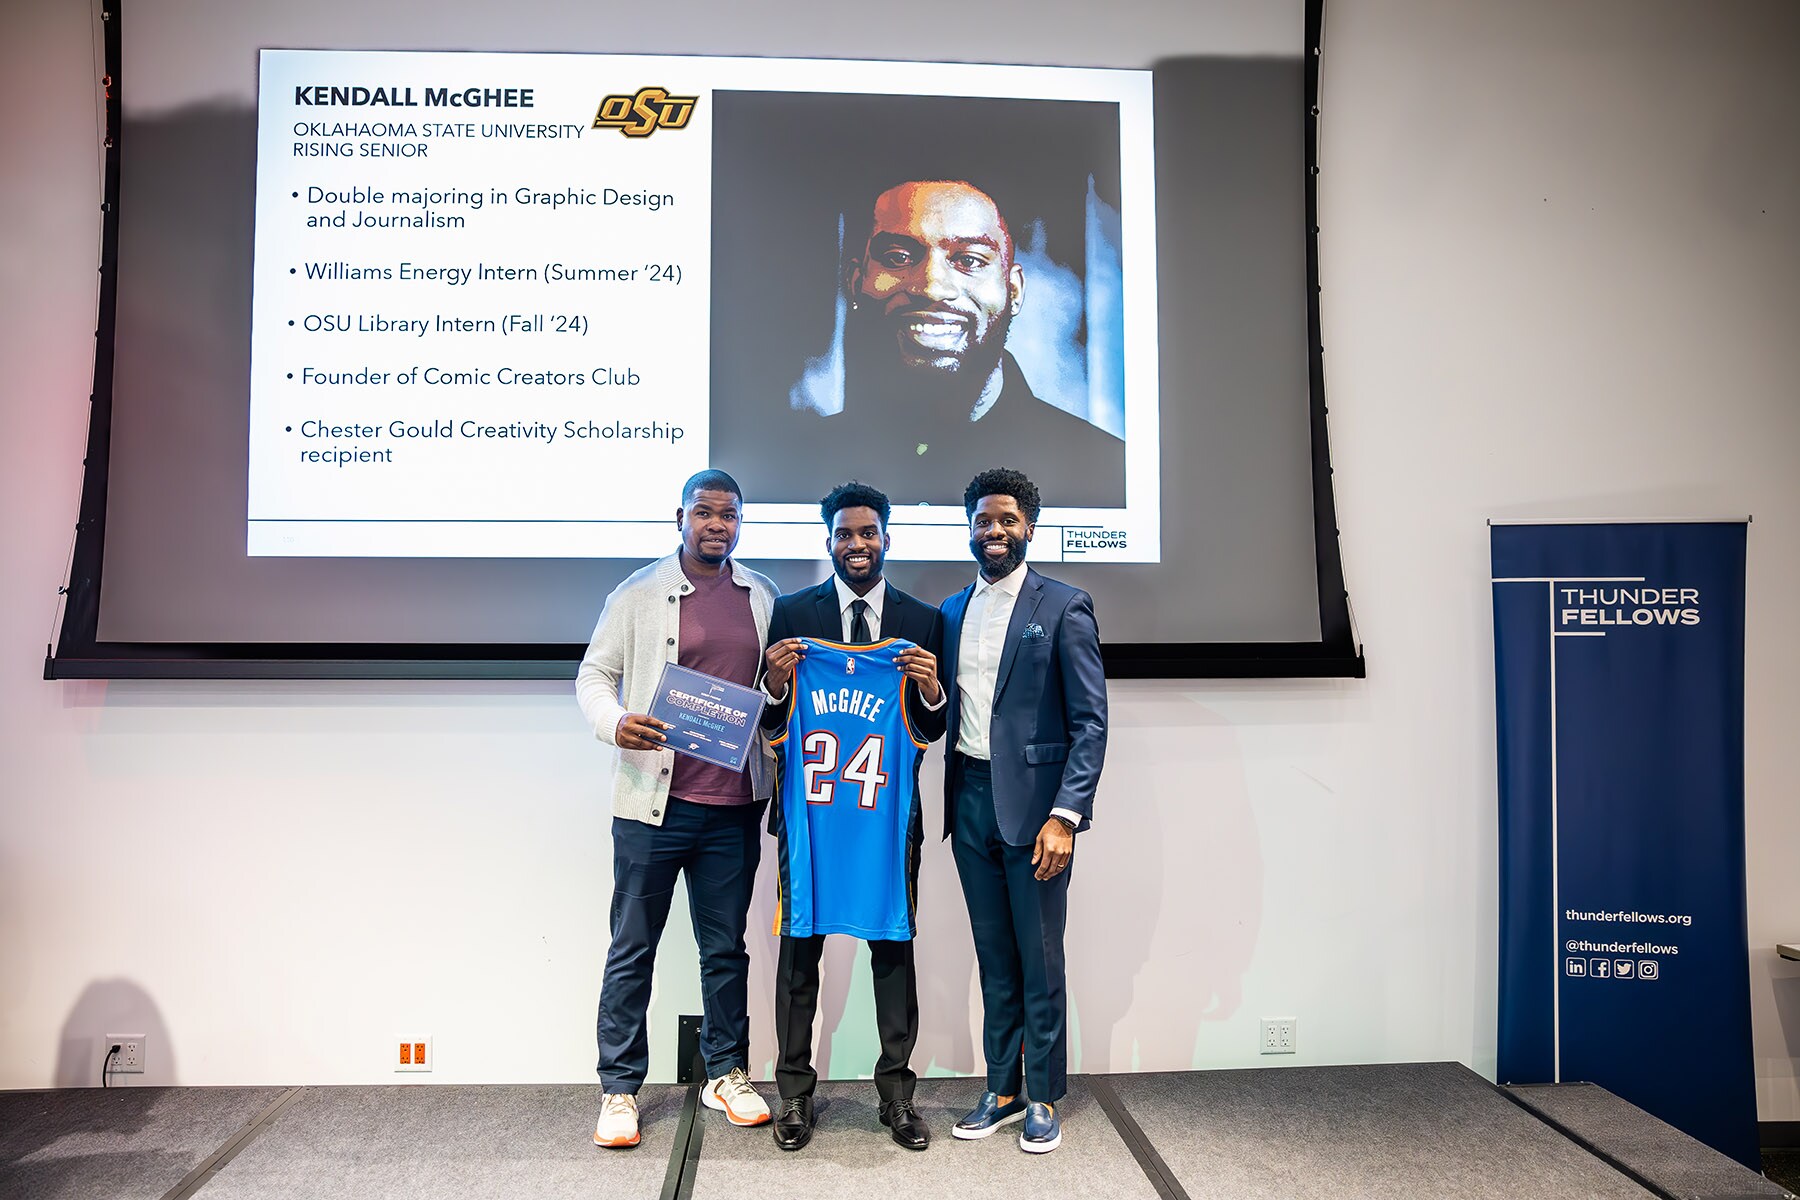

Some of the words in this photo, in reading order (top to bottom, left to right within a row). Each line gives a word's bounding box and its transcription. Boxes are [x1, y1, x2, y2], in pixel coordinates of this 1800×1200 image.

[294, 85, 418, 108] KENDALL
[425, 87, 534, 109] McGHEE
[590, 85, 700, 139] OSU
[293, 122, 417, 138] OKLAHAOMA
[422, 123, 476, 139] STATE
[481, 123, 585, 139] UNIVERSITY
[293, 142, 354, 158] RISING
[359, 142, 428, 158] SENIOR
[307, 185, 385, 205] Double
[391, 187, 484, 211] majoring
[490, 187, 509, 205] in
[515, 187, 597, 211] Graphic
[603, 188, 675, 212] Design
[306, 210, 346, 229] and
[352, 210, 465, 229] Journalism
[305, 261, 393, 281] Williams
[400, 263, 472, 286] Energy
[478, 264, 538, 282] Intern
[543, 263, 639, 284] (Summer
[303, 314, 352, 332] OSU
[359, 313, 429, 338] Library
[436, 315, 496, 333] Intern
[501, 313, 544, 335] (Fall
[302, 366, 391, 386] Founder
[396, 367, 418, 386] of
[423, 367, 491, 386] Comic
[497, 367, 585, 386] Creators
[591, 367, 641, 387] Club
[300, 419, 383, 440] Chester
[388, 419, 453, 440] Gould
[459, 421, 558, 444] Creativity
[563, 421, 684, 445] Scholarship
[300, 445, 393, 468] recipient
[1067, 530, 1127, 539] THUNDER
[1067, 540, 1127, 549] FELLOWS
[1560, 588, 1700, 605] THUNDER
[1562, 608, 1701, 626] FELLOWS
[811, 688, 885, 723] McGHEE
[802, 729, 890, 810] 24
[1565, 909, 1692, 927] thunderfellows.org
[1565, 939, 1679, 955] @thunderfellows
